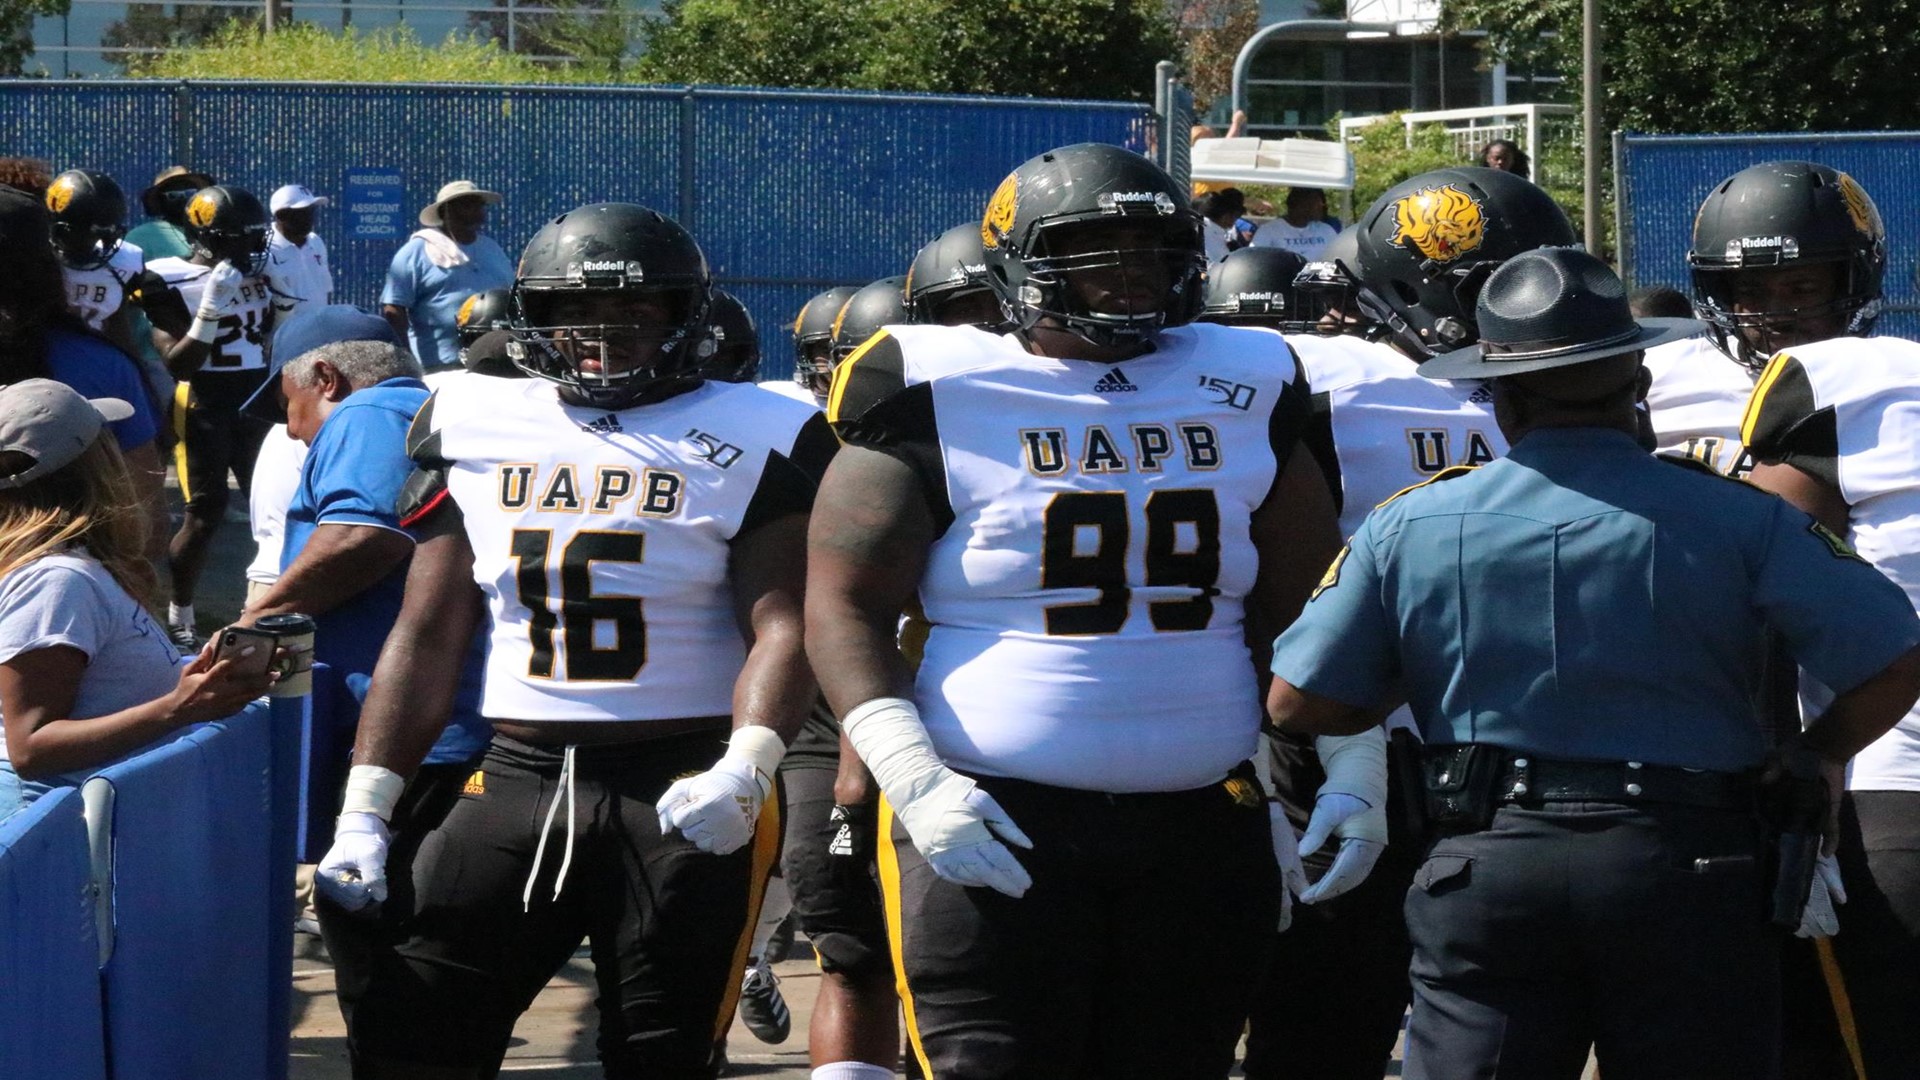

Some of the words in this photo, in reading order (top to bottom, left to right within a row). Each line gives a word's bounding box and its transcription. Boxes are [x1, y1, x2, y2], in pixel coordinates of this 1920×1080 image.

[350, 175, 400, 185] RESERVED
[1112, 192, 1154, 202] Riddell
[352, 204, 400, 212] ASSISTANT
[361, 215, 390, 223] HEAD
[356, 225, 396, 234] COACH
[1742, 236, 1782, 248] Riddell
[583, 260, 625, 271] Riddell
[965, 263, 987, 273] Ridd
[75, 284, 107, 303] PB
[1240, 292, 1271, 300] Riddell
[1094, 383, 1138, 393] adidas
[1019, 421, 1224, 477] UAPB
[1405, 427, 1496, 476] UA
[1684, 436, 1757, 480] UA
[498, 462, 686, 519] UAPB
[1041, 488, 1221, 636] 99
[508, 528, 648, 682] 16
